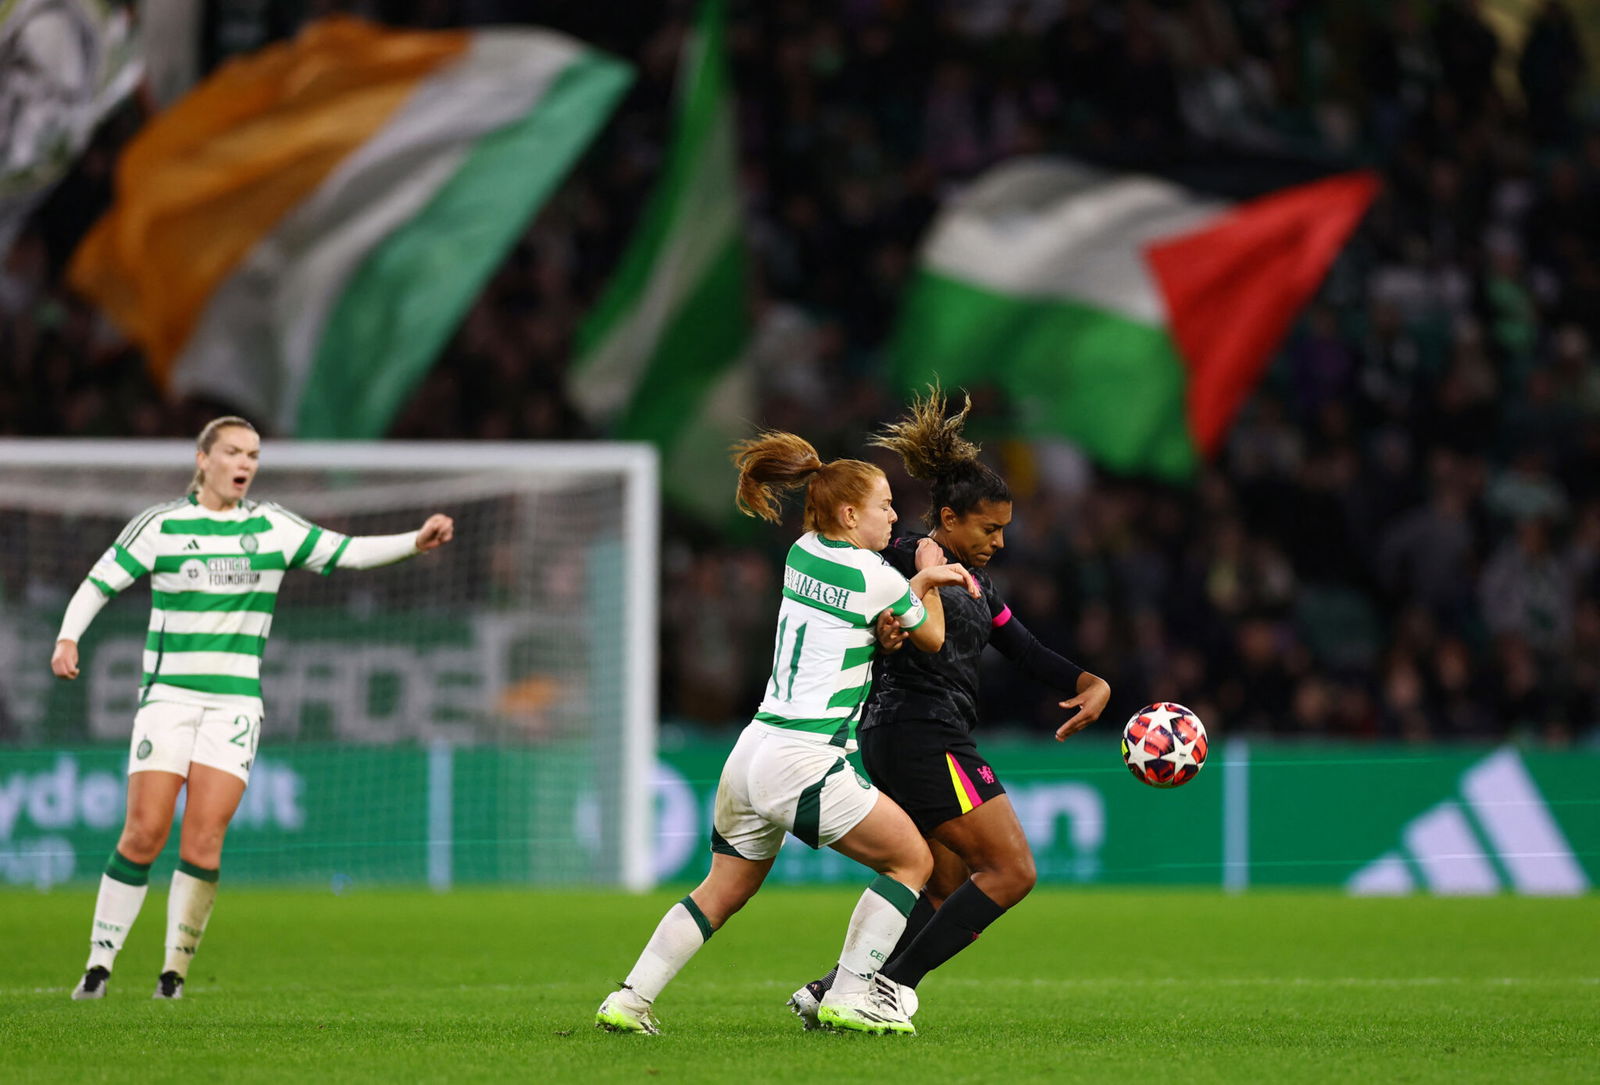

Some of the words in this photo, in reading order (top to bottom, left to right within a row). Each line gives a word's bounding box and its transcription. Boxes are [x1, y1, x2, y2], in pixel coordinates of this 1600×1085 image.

[208, 558, 236, 572] CELTIC
[209, 572, 261, 586] FOUNDATION
[785, 567, 851, 609] AVANAGH
[771, 614, 808, 703] 11
